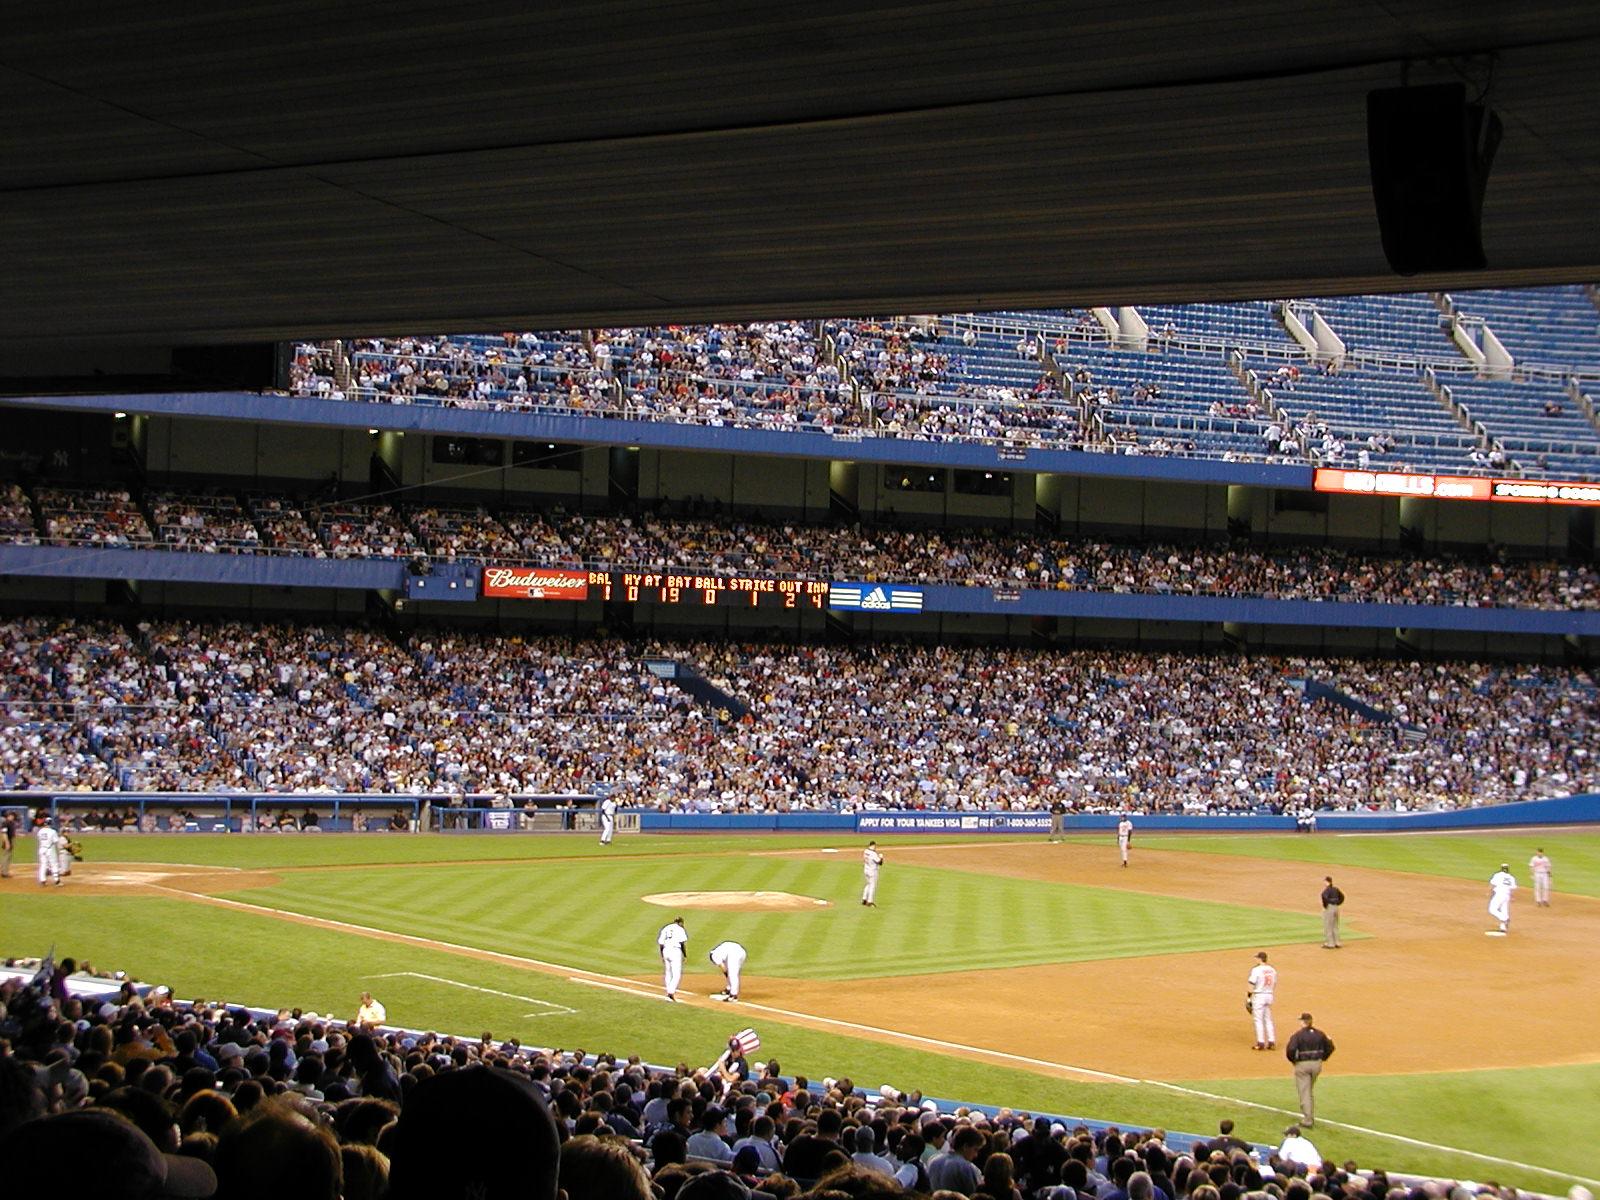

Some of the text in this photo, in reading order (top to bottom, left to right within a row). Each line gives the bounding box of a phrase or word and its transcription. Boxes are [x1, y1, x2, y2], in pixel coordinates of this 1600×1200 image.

[485, 568, 587, 588] Budweiser
[588, 572, 612, 585] BAL
[644, 575, 663, 587] AT
[667, 575, 693, 588] BAT
[694, 577, 726, 590] BALL
[729, 578, 775, 592] STRIKE
[779, 580, 803, 593] OUT
[605, 585, 822, 608] 1 0 19 0 1 2 4
[861, 600, 891, 610] adidas
[859, 818, 880, 827] APPLY
[880, 818, 895, 827] FOR
[896, 818, 915, 827] YOUR
[916, 818, 945, 828] YANKEES
[945, 818, 961, 828] VISA
